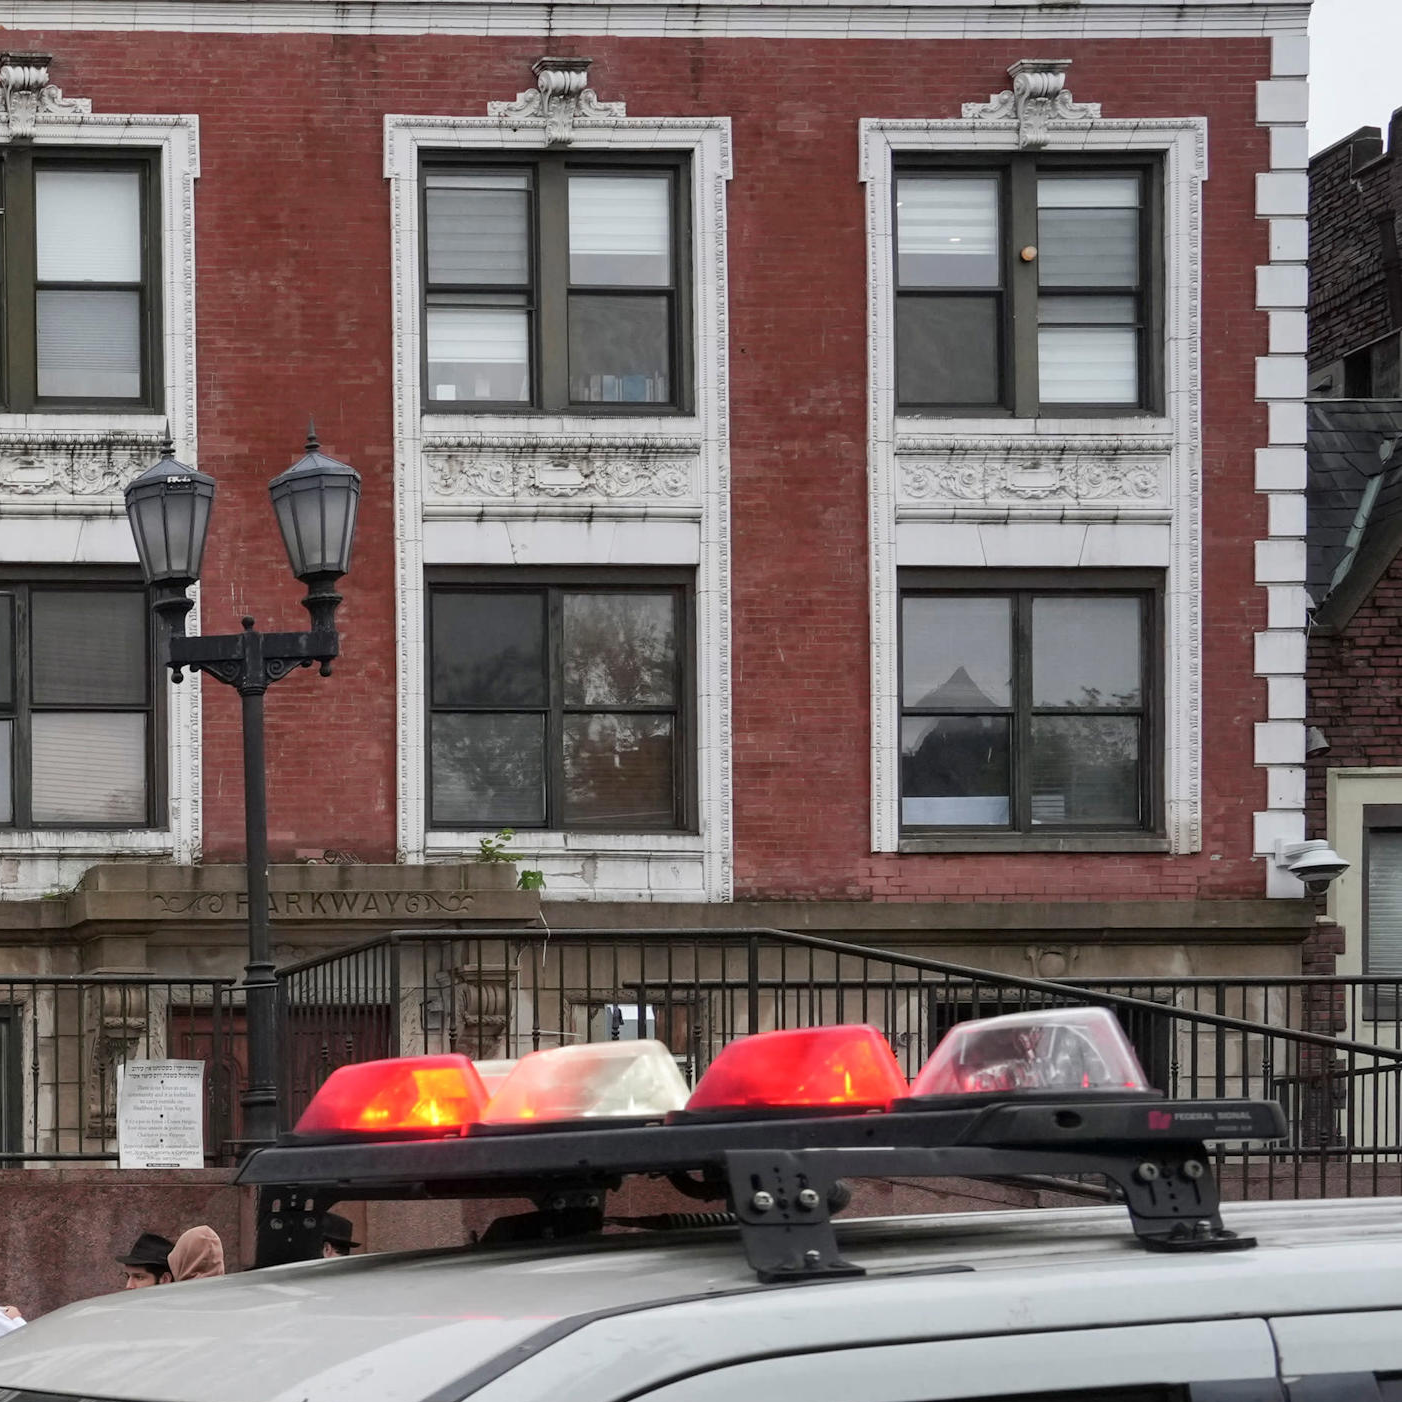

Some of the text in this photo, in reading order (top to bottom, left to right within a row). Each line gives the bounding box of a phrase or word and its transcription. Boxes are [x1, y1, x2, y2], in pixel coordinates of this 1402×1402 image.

[235, 892, 399, 915] PARKWAY
[1174, 1111, 1252, 1121] FEDERAL SIGNAL
